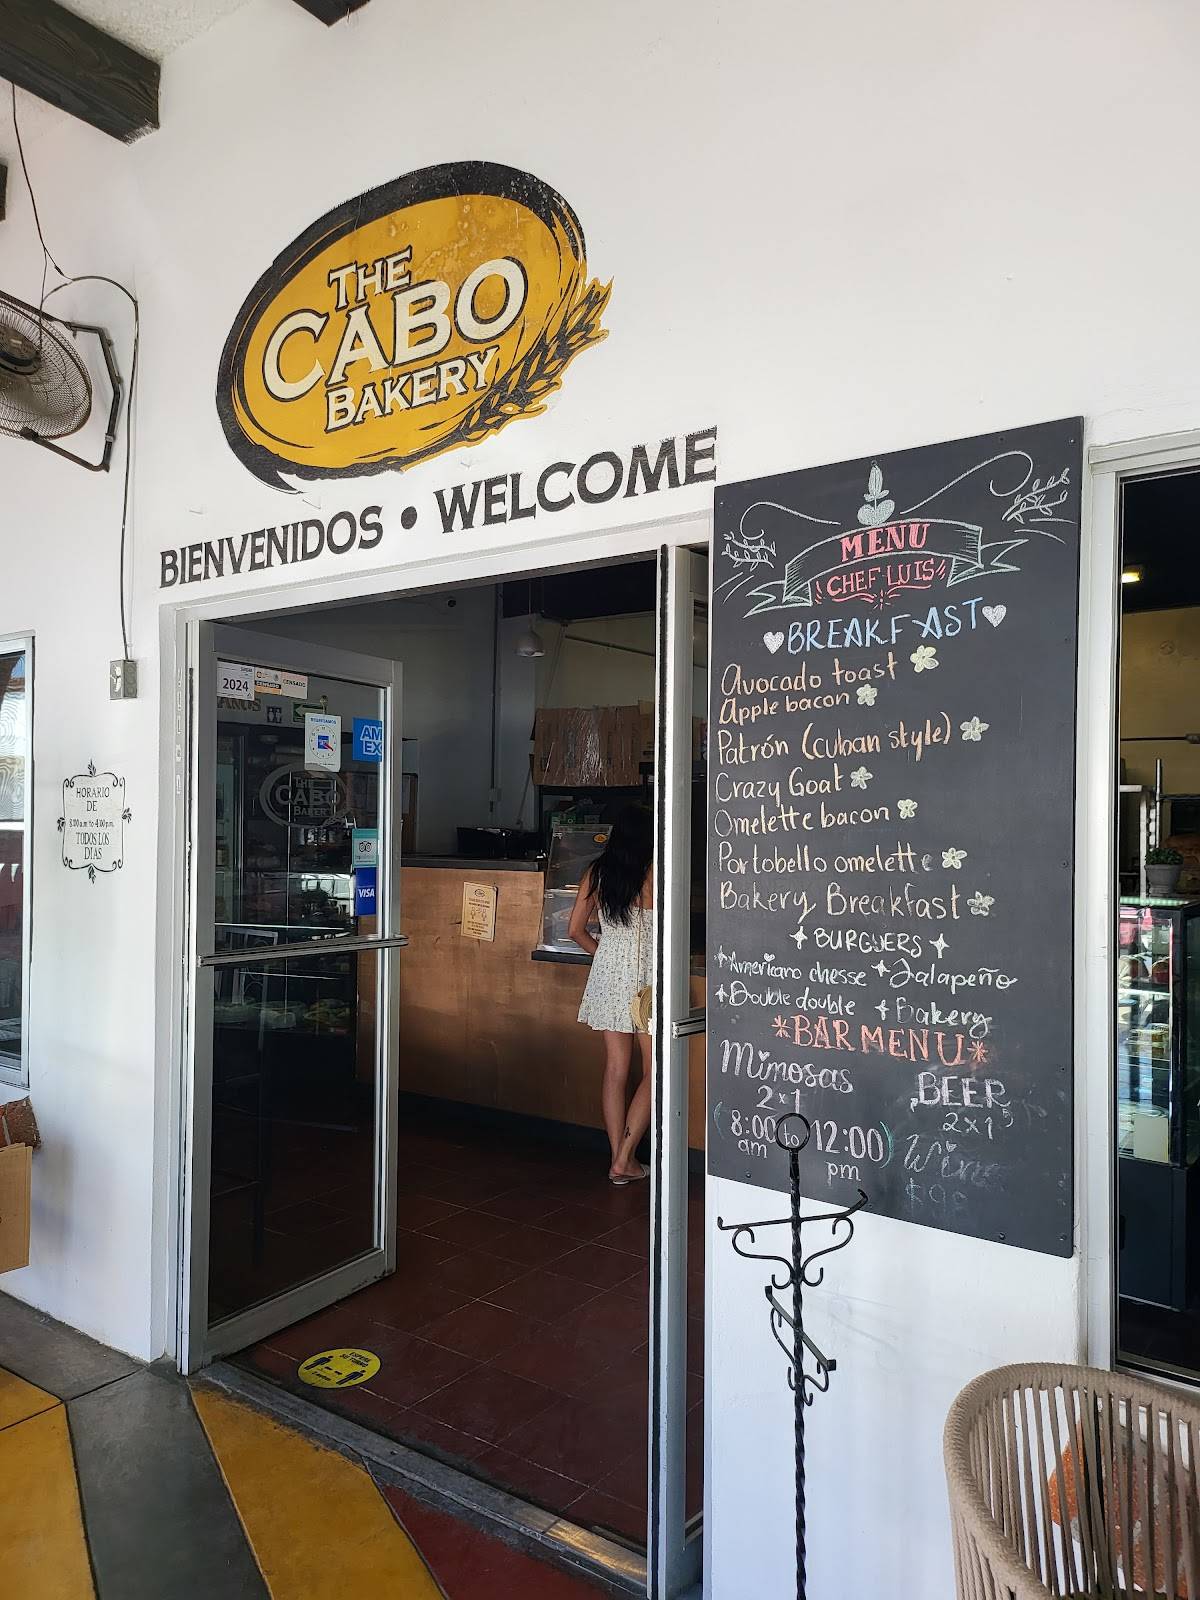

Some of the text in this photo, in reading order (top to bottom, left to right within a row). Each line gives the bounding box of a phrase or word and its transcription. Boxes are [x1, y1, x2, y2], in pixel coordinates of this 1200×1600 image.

[330, 246, 412, 311] THE
[262, 256, 528, 401] CABO
[325, 347, 500, 434] BAKERY
[159, 425, 717, 589] BIENVENIDOS WELCOME
[840, 523, 930, 563] MENU
[826, 559, 935, 595] CHEF LUIS
[787, 597, 983, 655] BREAKFAST
[223, 678, 248, 692] 2024
[832, 651, 898, 686] toast
[786, 692, 850, 713] bacon
[717, 729, 789, 766] Patrón
[888, 711, 951, 762] style)
[76, 787, 110, 798] HORARIO
[714, 764, 844, 807] Crazy Goat
[87, 801, 97, 812] DE
[714, 801, 890, 838] Omelette bacon
[76, 832, 110, 845] TODOS LOS
[84, 847, 103, 860] DIAS
[718, 841, 934, 874] Portobello omelette
[358, 888, 375, 898] VISA
[719, 880, 961, 924] Bakery Breakfast
[890, 957, 1018, 995] Jalapeño
[729, 980, 993, 1039] Double double Bakery
[719, 1039, 853, 1094] Mimosas
[918, 1071, 1011, 1109] BEER
[738, 1138, 768, 1159] am
[783, 1122, 800, 1147] to
[824, 1161, 862, 1187] pm
